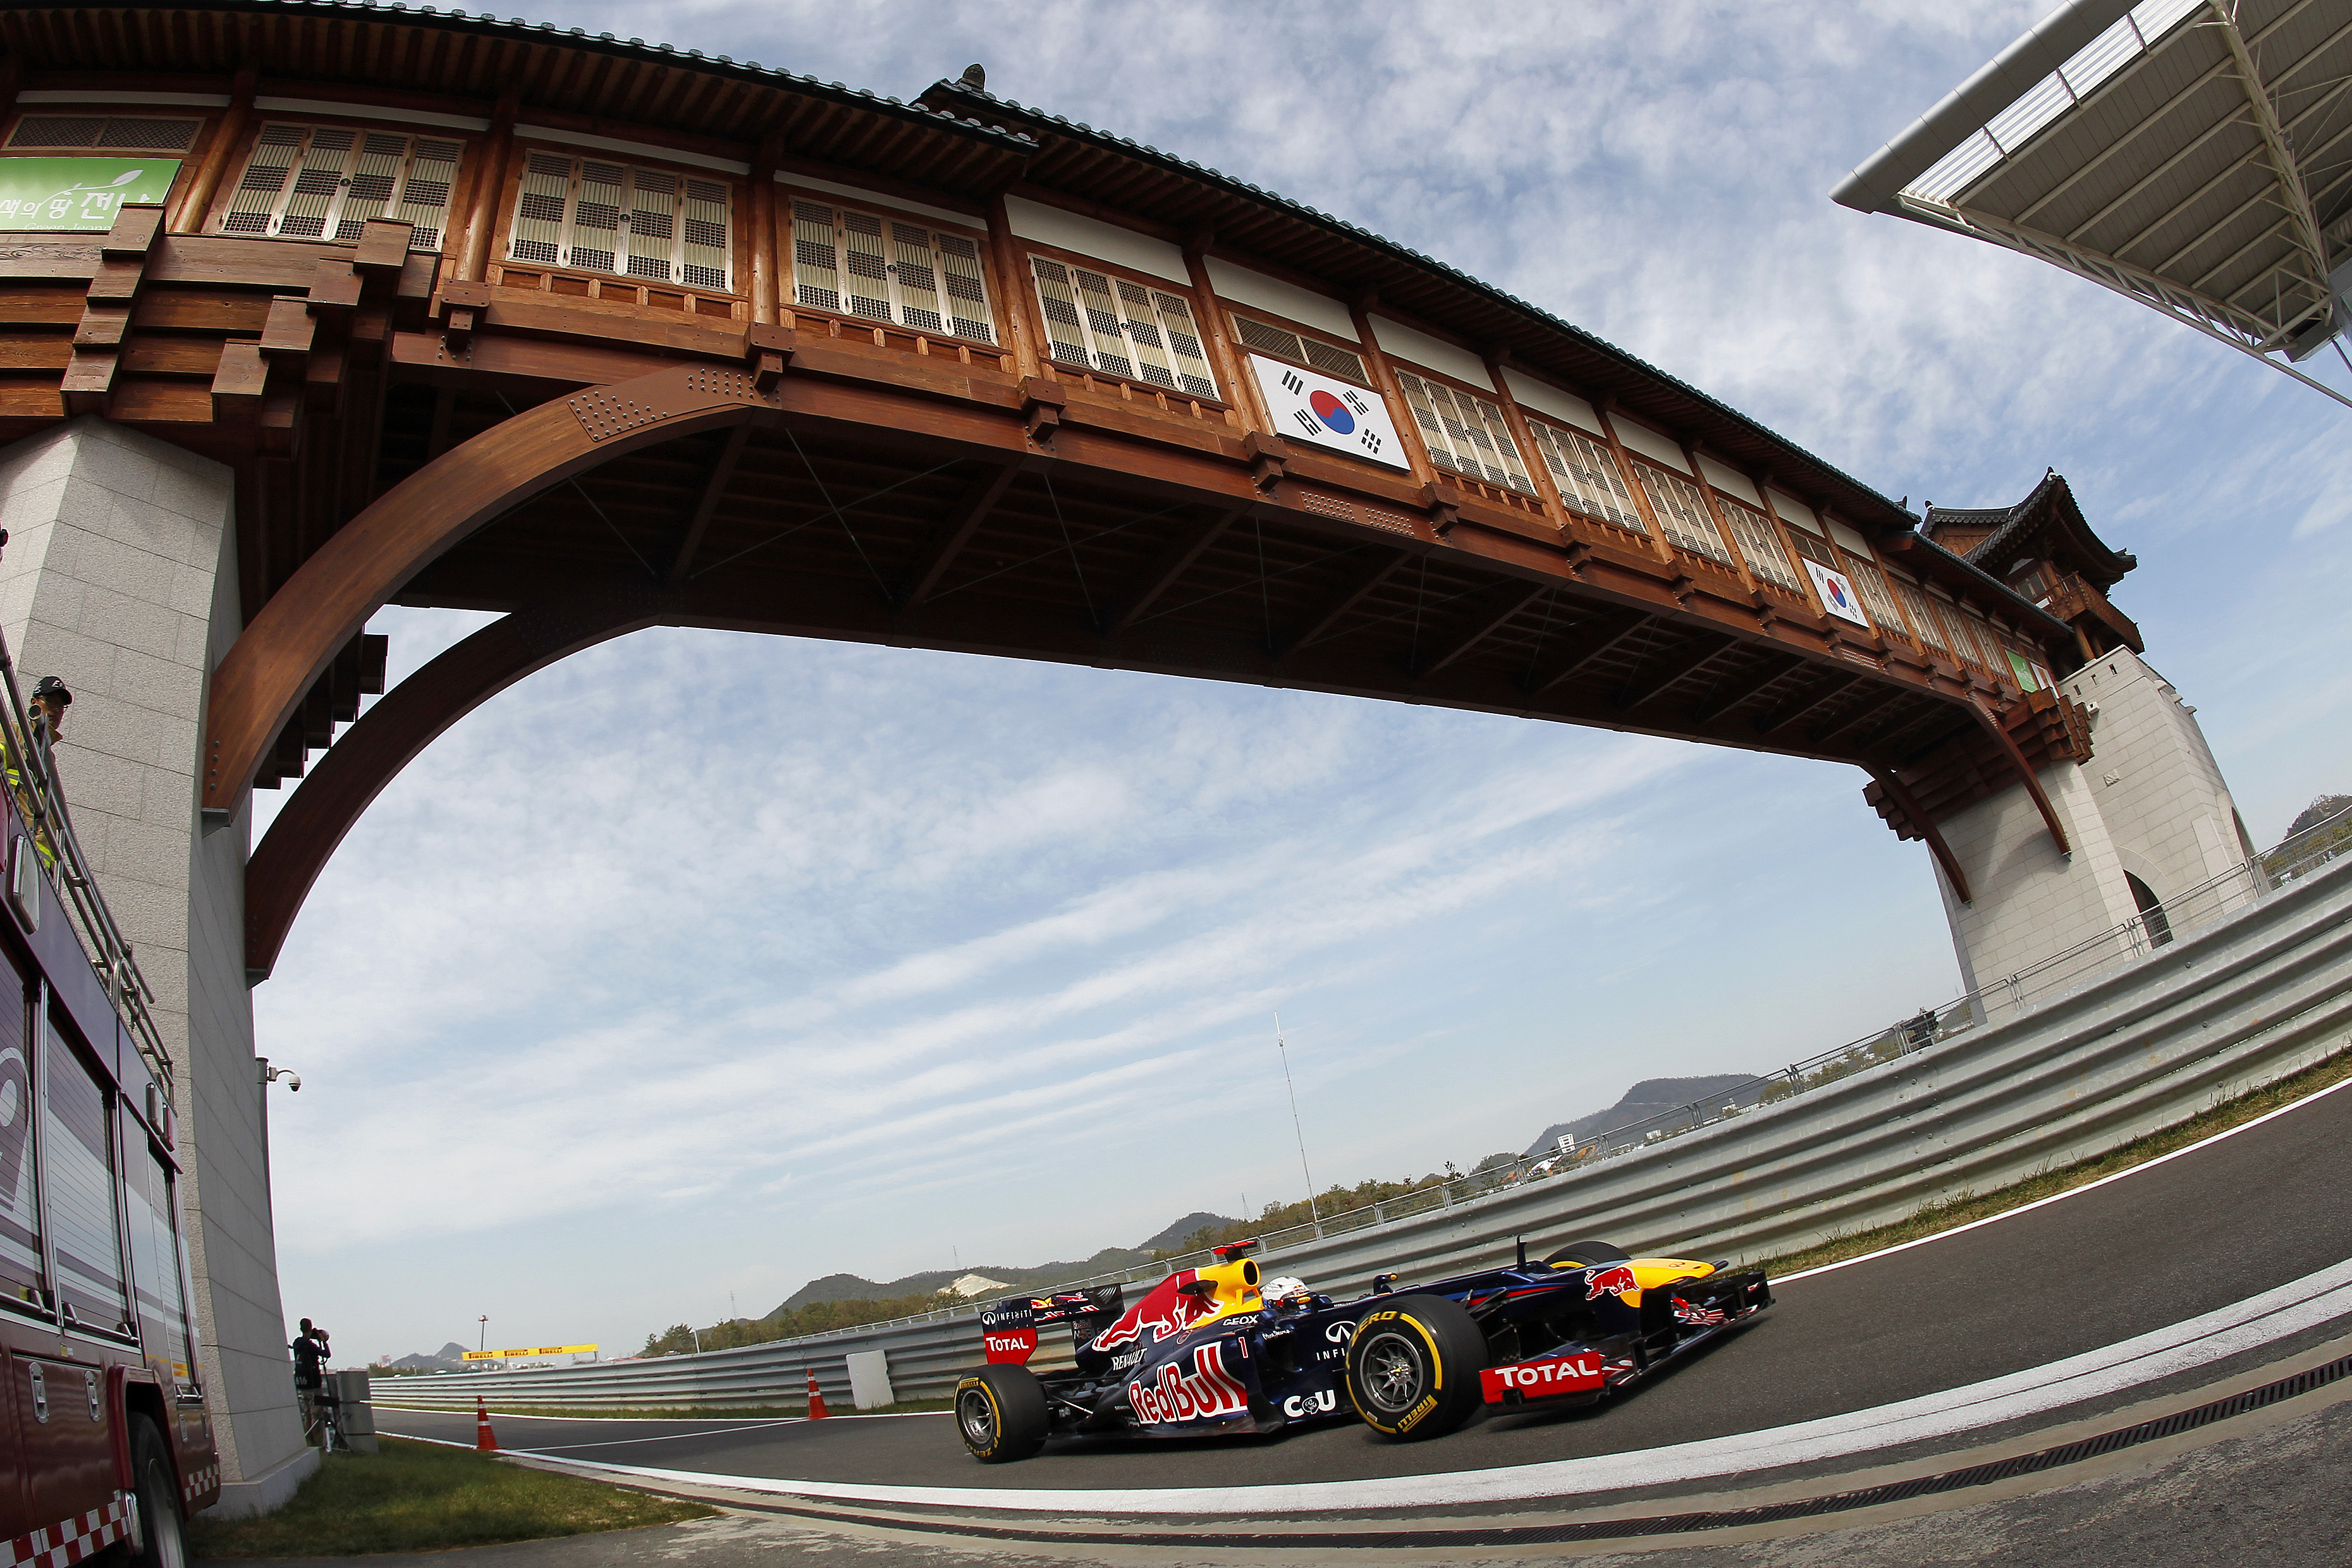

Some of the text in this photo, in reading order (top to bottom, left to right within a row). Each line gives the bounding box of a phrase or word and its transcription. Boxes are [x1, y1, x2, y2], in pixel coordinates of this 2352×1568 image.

[0, 199, 42, 219] 색의
[49, 199, 73, 219] 땅
[997, 1309, 1032, 1321] INFINITI
[1223, 1314, 1259, 1326] GEOX
[1351, 1311, 1398, 1348] ZERO
[986, 1337, 1029, 1352] TOTAL
[1239, 1336, 1249, 1359] 1
[1316, 1347, 1345, 1361] INFI
[1111, 1347, 1148, 1371] RENAULT
[959, 1377, 979, 1389] PIRELLI
[1495, 1359, 1598, 1387] TOTAL
[1397, 1394, 1438, 1433] PIRELLI
